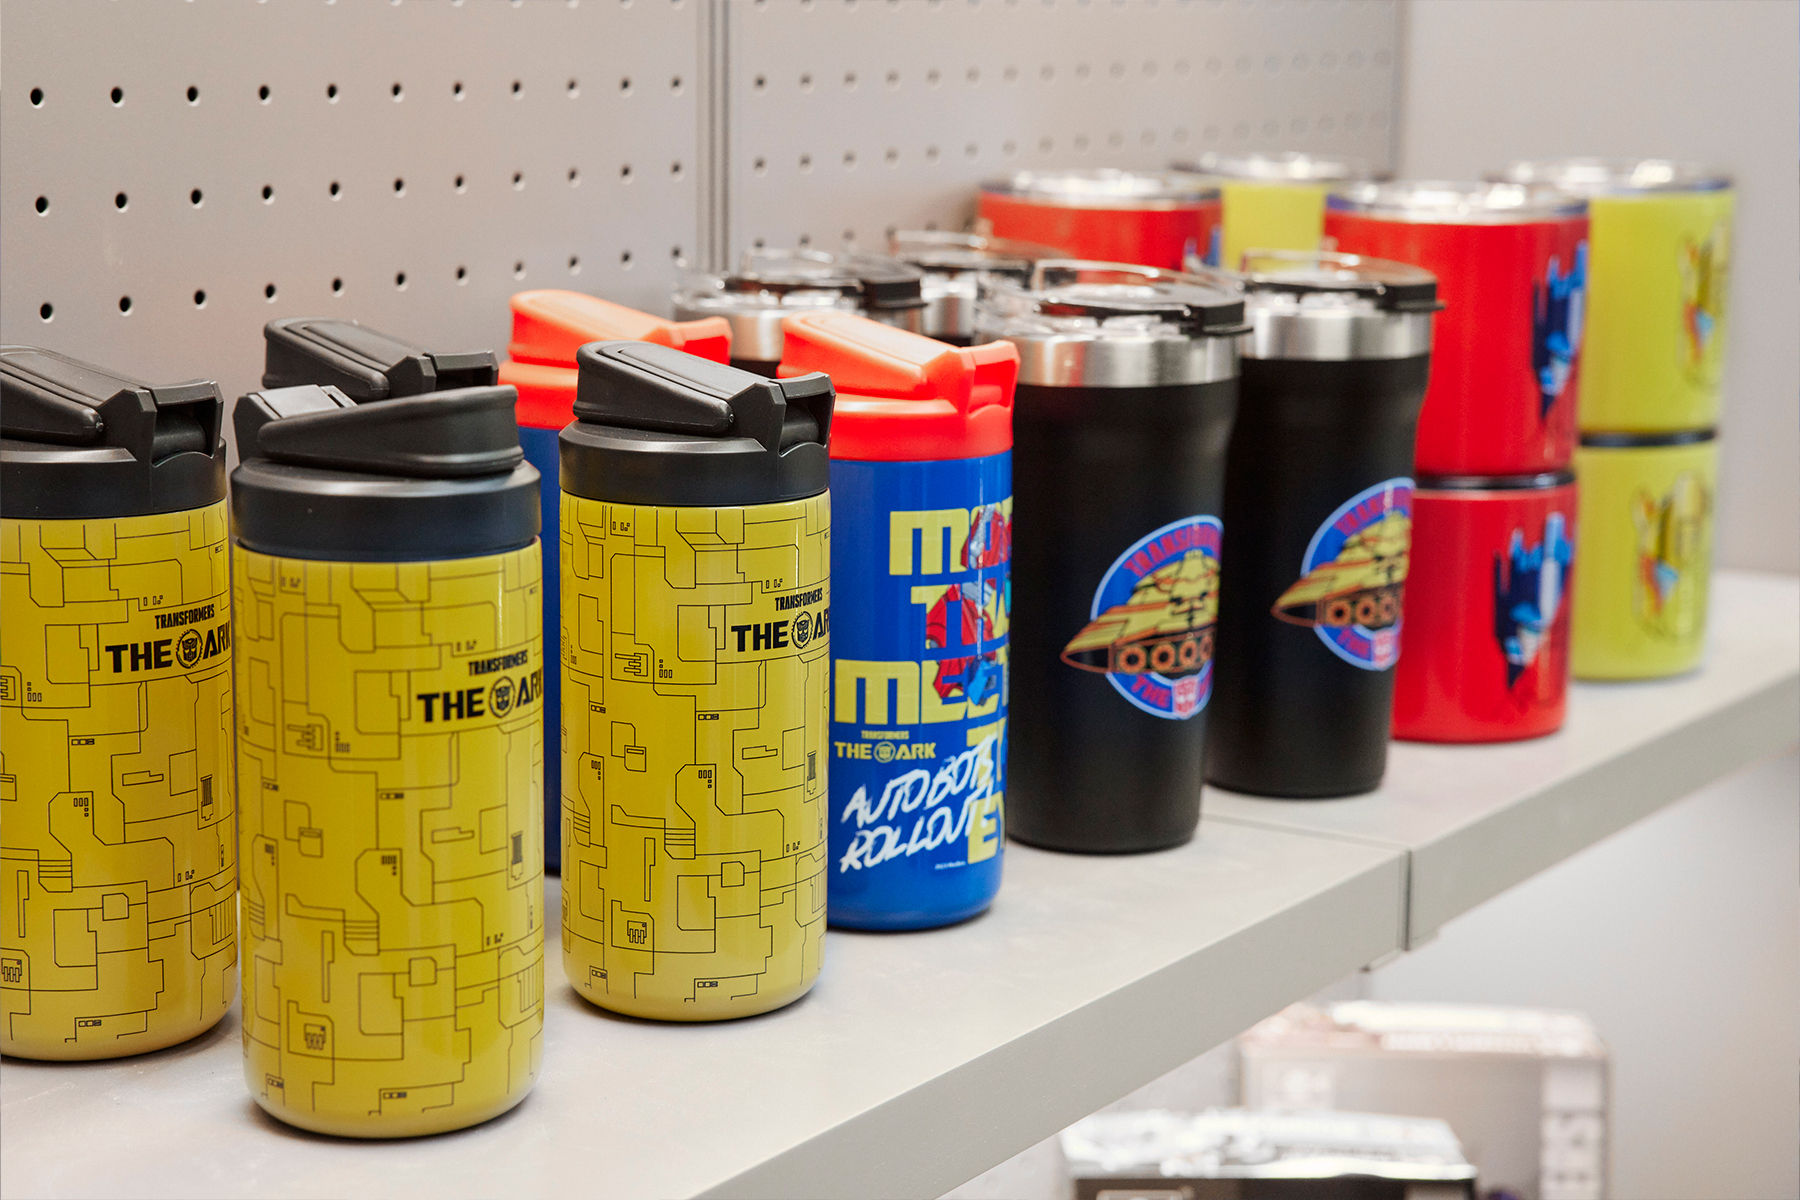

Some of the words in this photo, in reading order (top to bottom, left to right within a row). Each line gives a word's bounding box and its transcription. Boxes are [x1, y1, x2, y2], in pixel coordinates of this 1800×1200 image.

[775, 588, 823, 611] TRANSFORMERS
[155, 604, 215, 630] TRANSFORMERS
[731, 620, 789, 652] THE
[105, 638, 173, 674] THE
[469, 649, 528, 677] TRANSFORMERS
[417, 687, 485, 723] THE
[834, 741, 873, 760] THE
[895, 742, 937, 760] ARK
